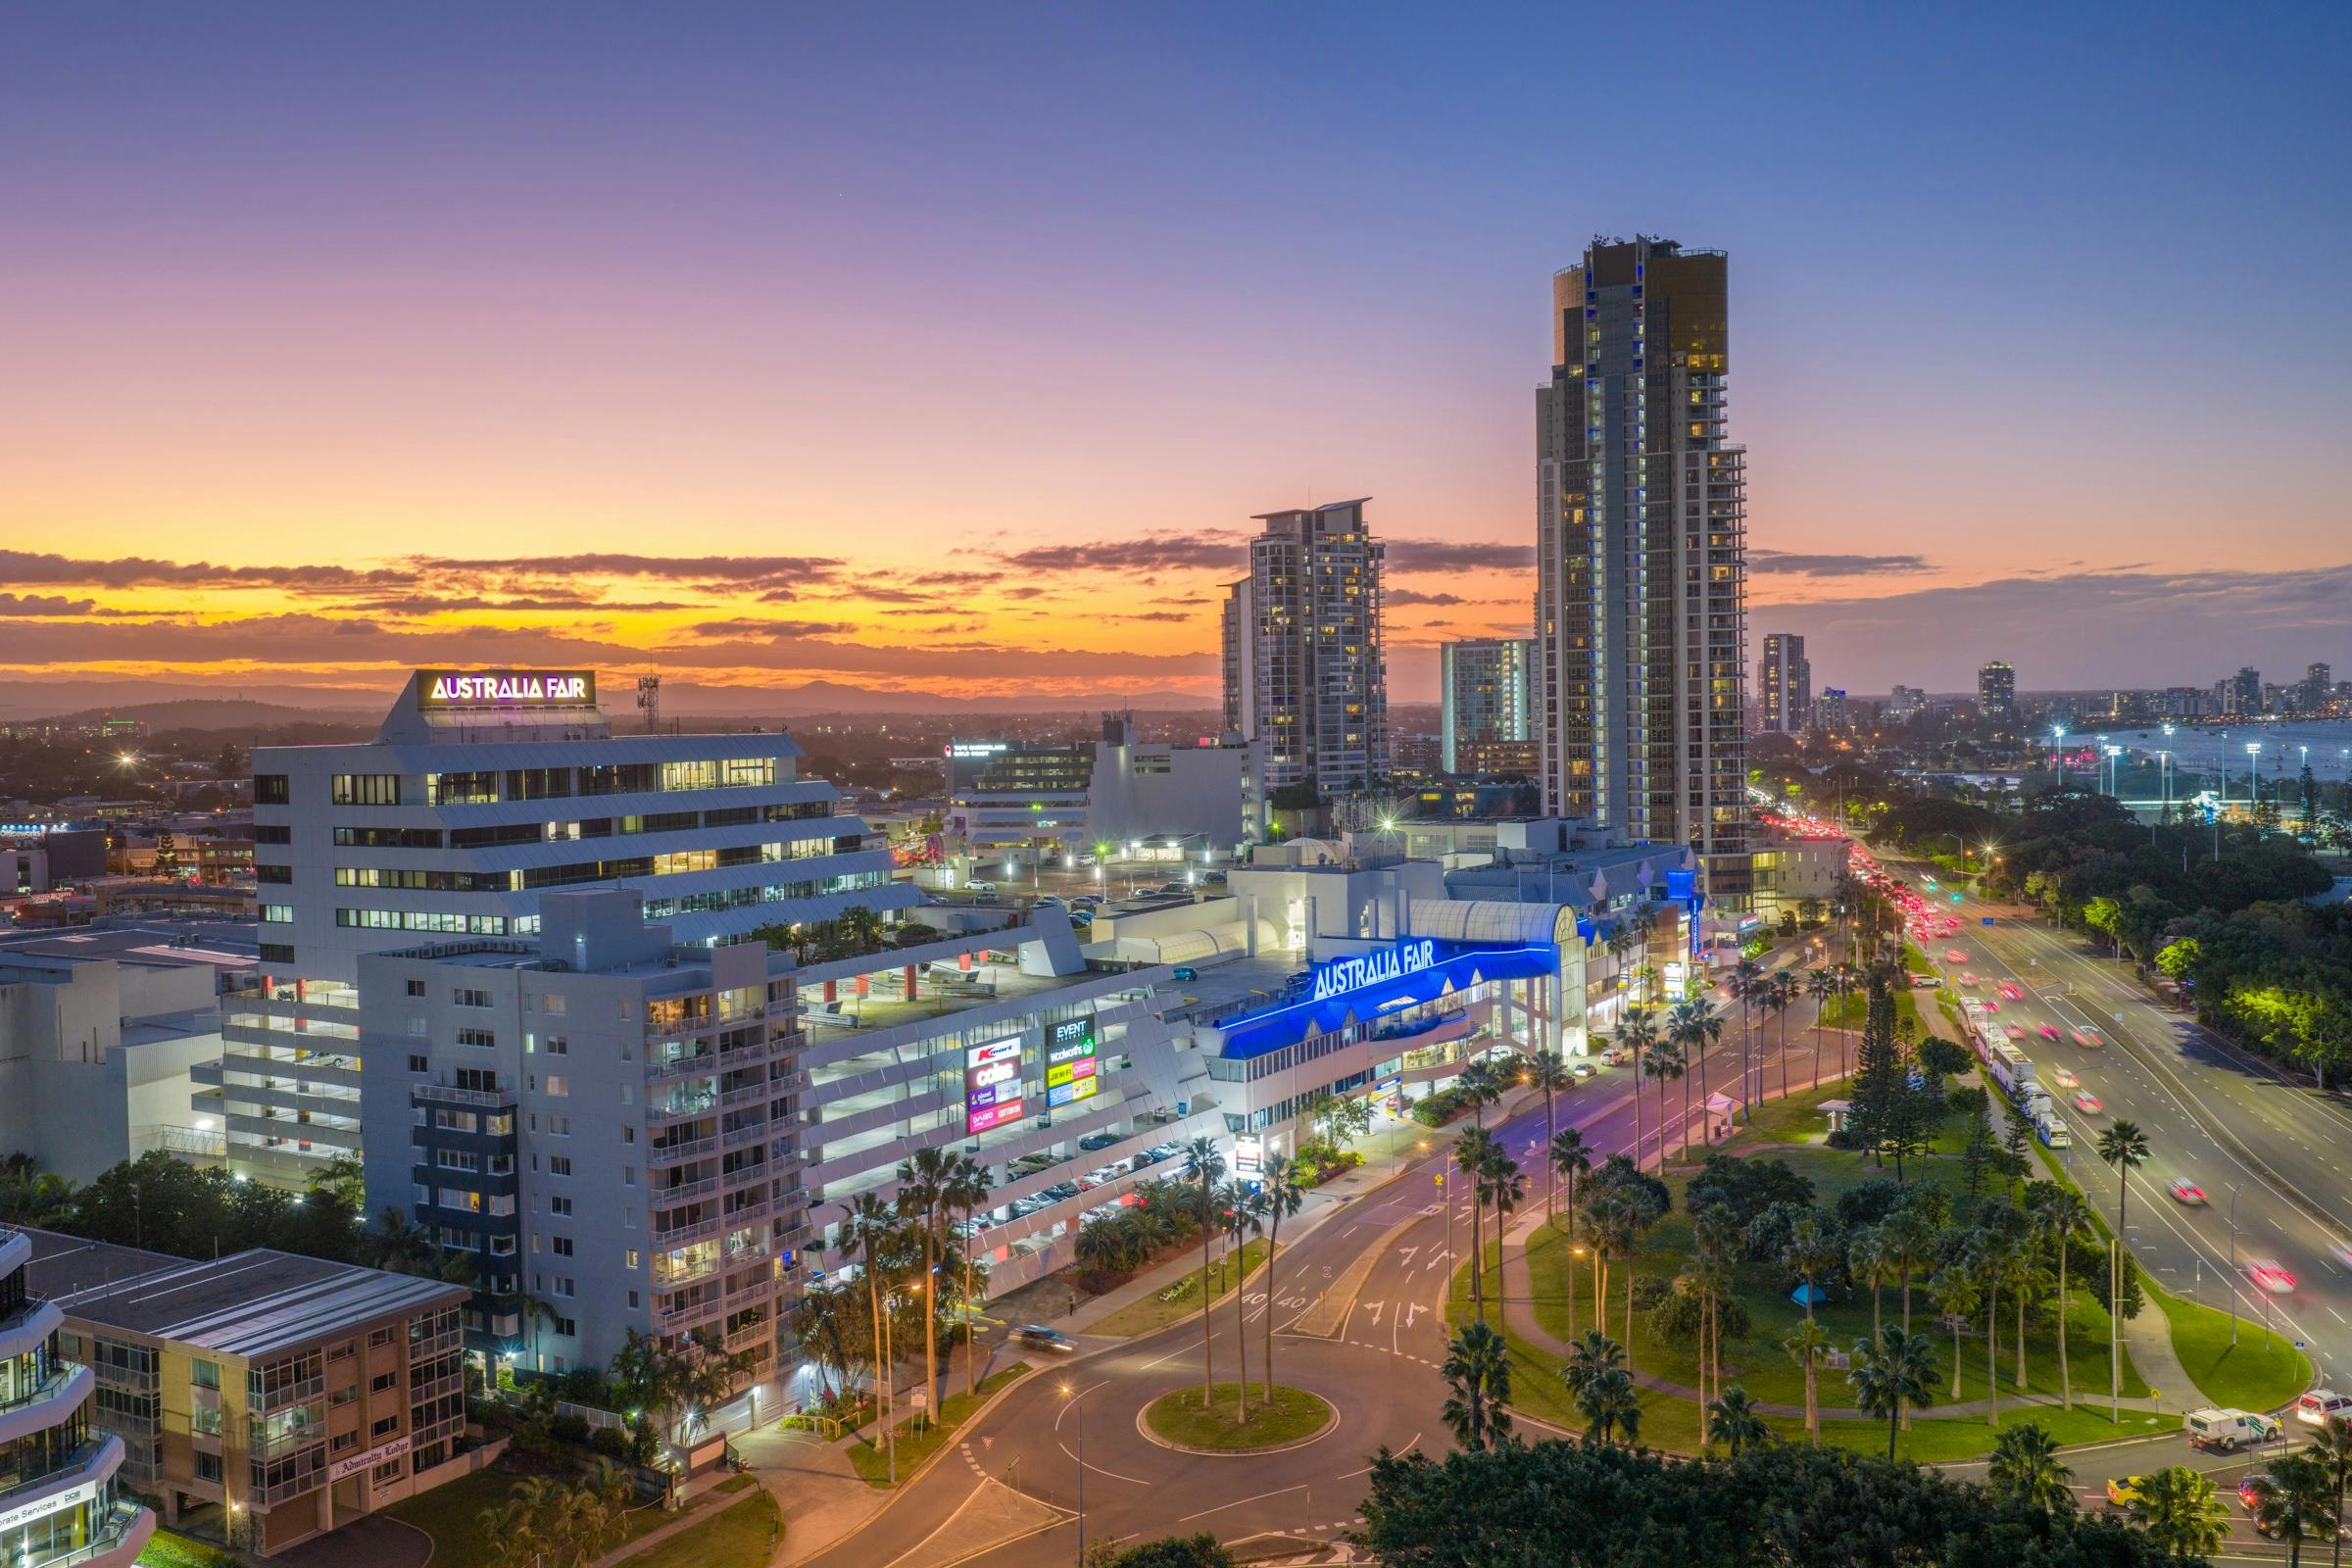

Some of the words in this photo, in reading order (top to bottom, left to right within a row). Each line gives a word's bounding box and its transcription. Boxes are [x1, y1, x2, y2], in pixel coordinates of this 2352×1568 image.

[431, 677, 544, 699] AUSTRALIA
[547, 677, 585, 698] FAIR
[1314, 949, 1401, 1001] AUSTRALIA
[1403, 940, 1435, 973] FAIR
[1057, 1020, 1087, 1038] EVENT
[978, 1045, 1013, 1061] Kmart
[973, 1112, 994, 1124] DAISO
[1242, 1292, 1267, 1304] 40
[1278, 1296, 1306, 1308] 40
[342, 1451, 382, 1473] Admiralty
[385, 1442, 409, 1456] Lodge
[22, 1500, 57, 1518] Services
